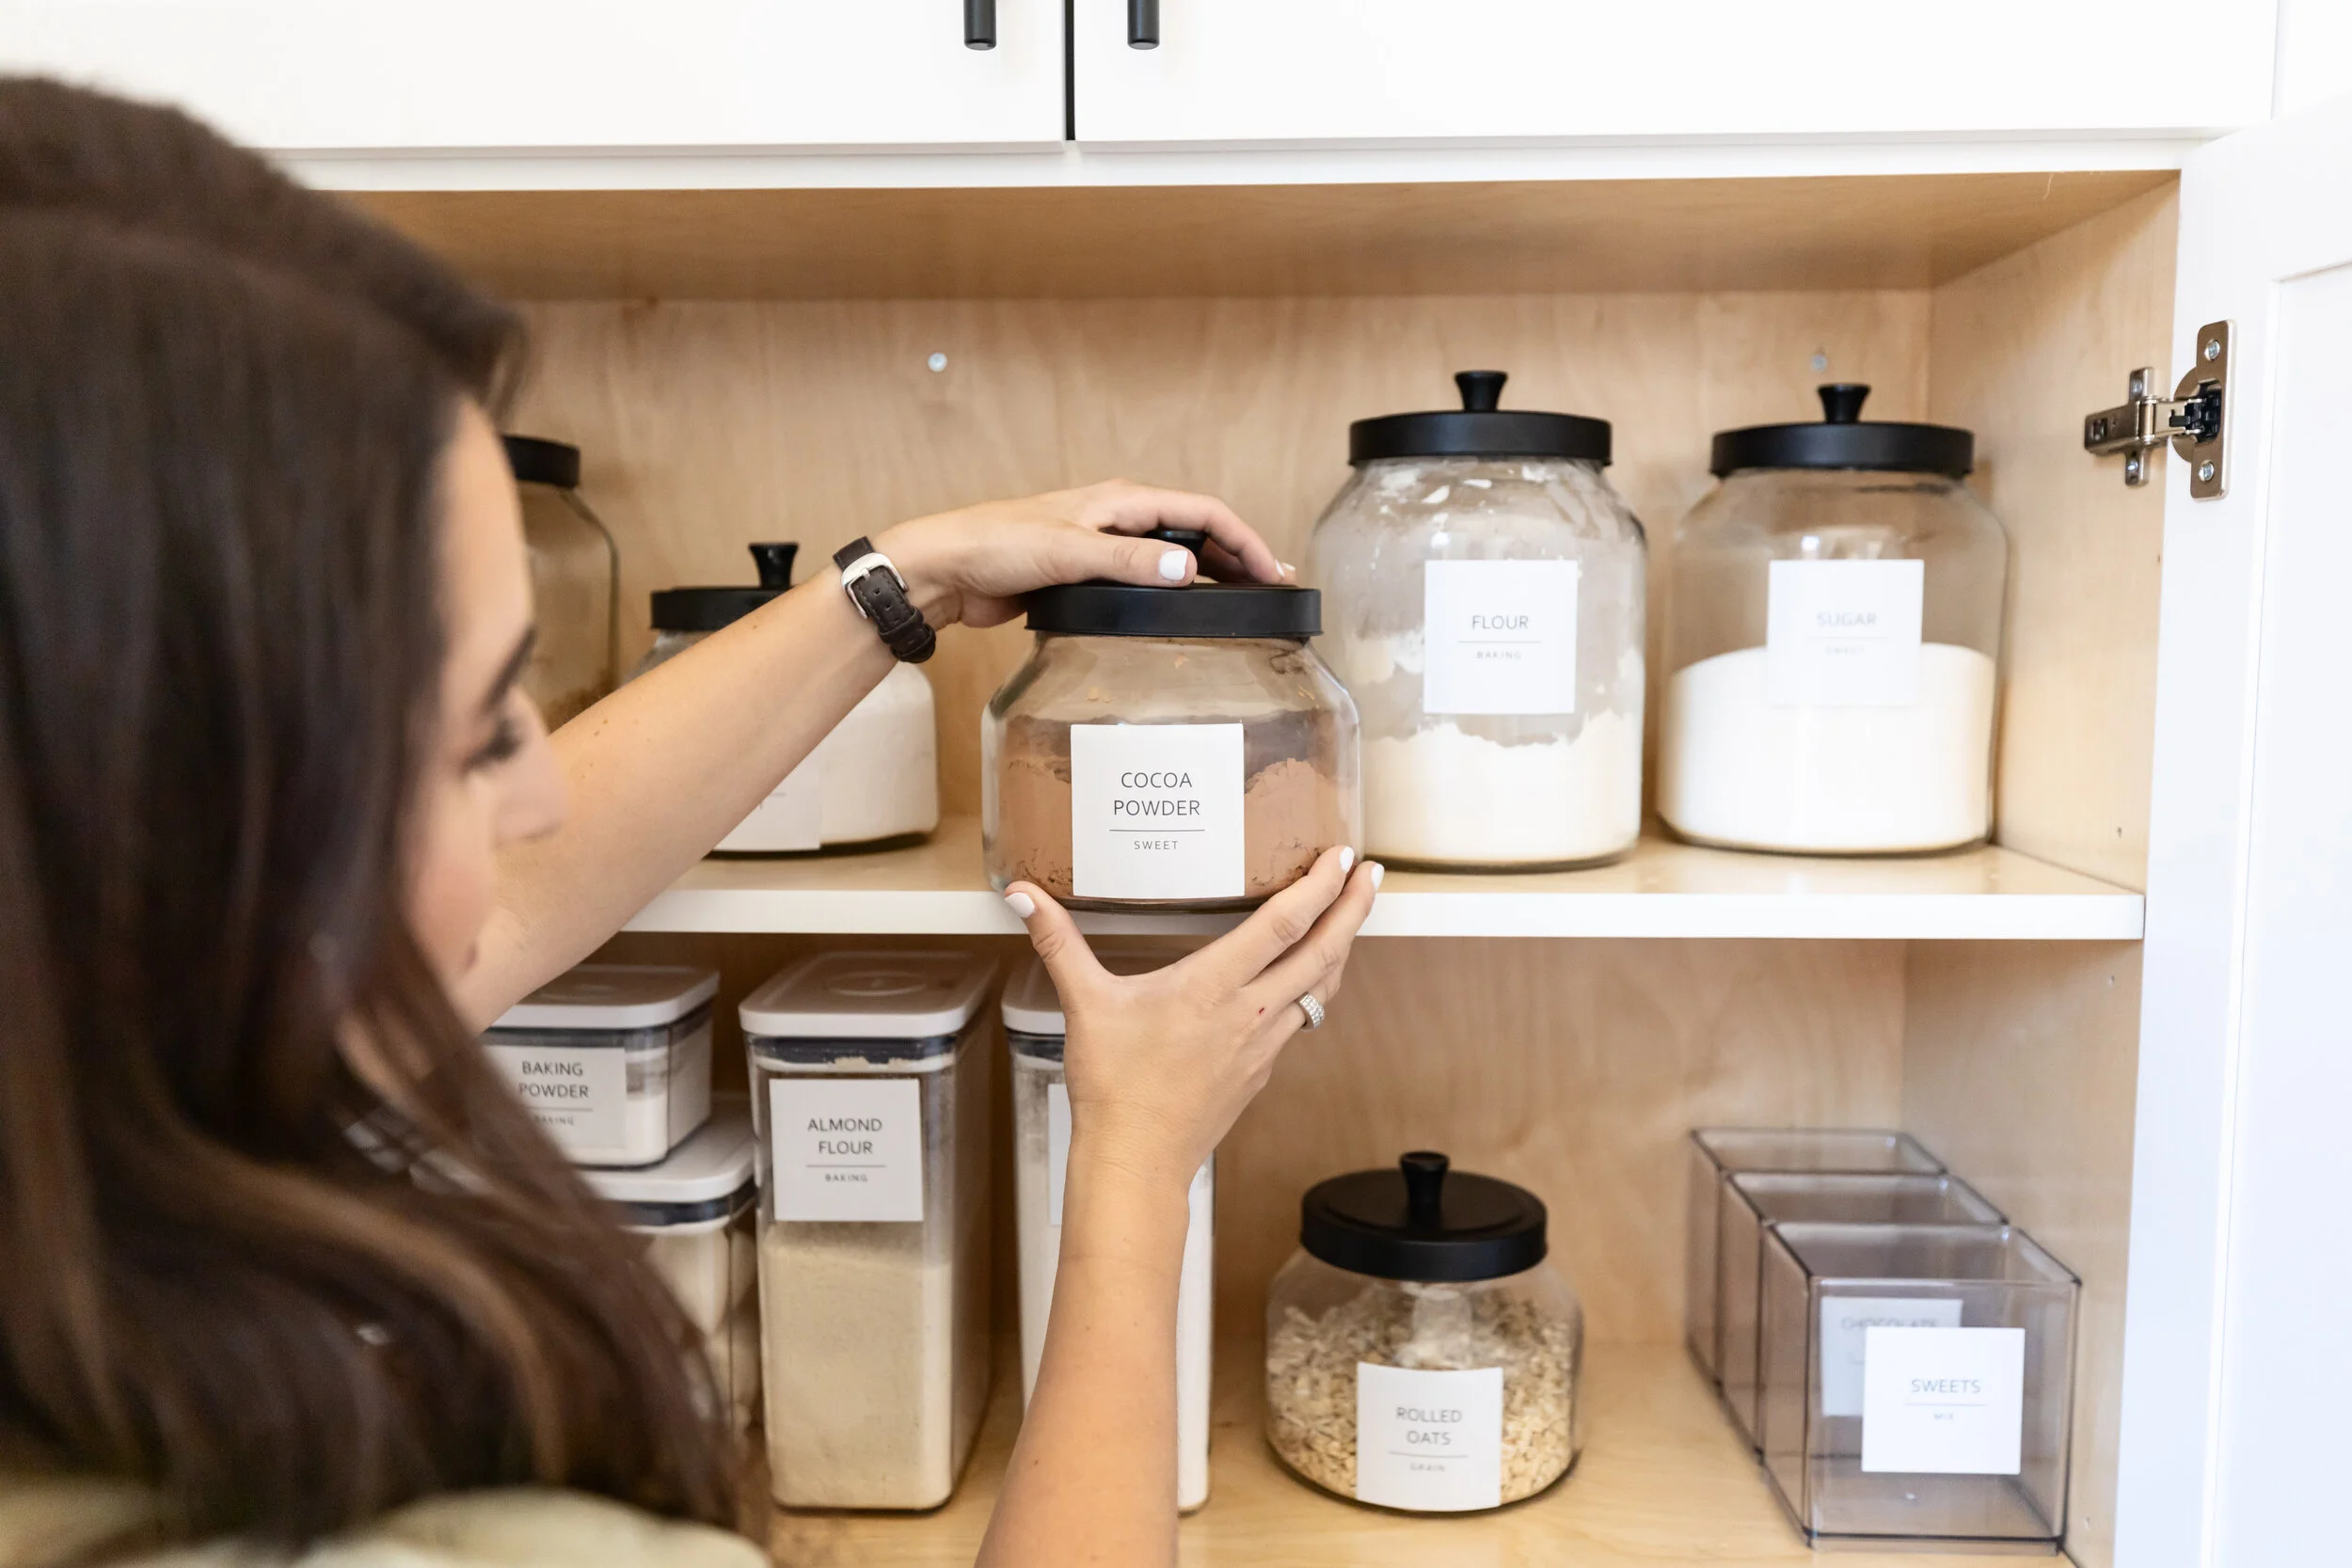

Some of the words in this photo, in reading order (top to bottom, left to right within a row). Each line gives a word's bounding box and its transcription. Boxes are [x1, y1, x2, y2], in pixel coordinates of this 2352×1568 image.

[1471, 614, 1529, 629] FLOUR
[1816, 611, 1878, 627] SUGAR
[1120, 771, 1193, 788] COCOA
[1113, 800, 1200, 816] POWDER
[1134, 840, 1179, 850] SWEET
[521, 1060, 584, 1077] BAKING
[518, 1082, 589, 1099] POWDER
[807, 1117, 883, 1132] ALMOND
[818, 1140, 874, 1155] FLOUR
[824, 1173, 868, 1182] BAKING
[1911, 1378, 1981, 1394] SWEETS
[1395, 1406, 1464, 1423] ROLLED
[1406, 1430, 1453, 1446] OATS
